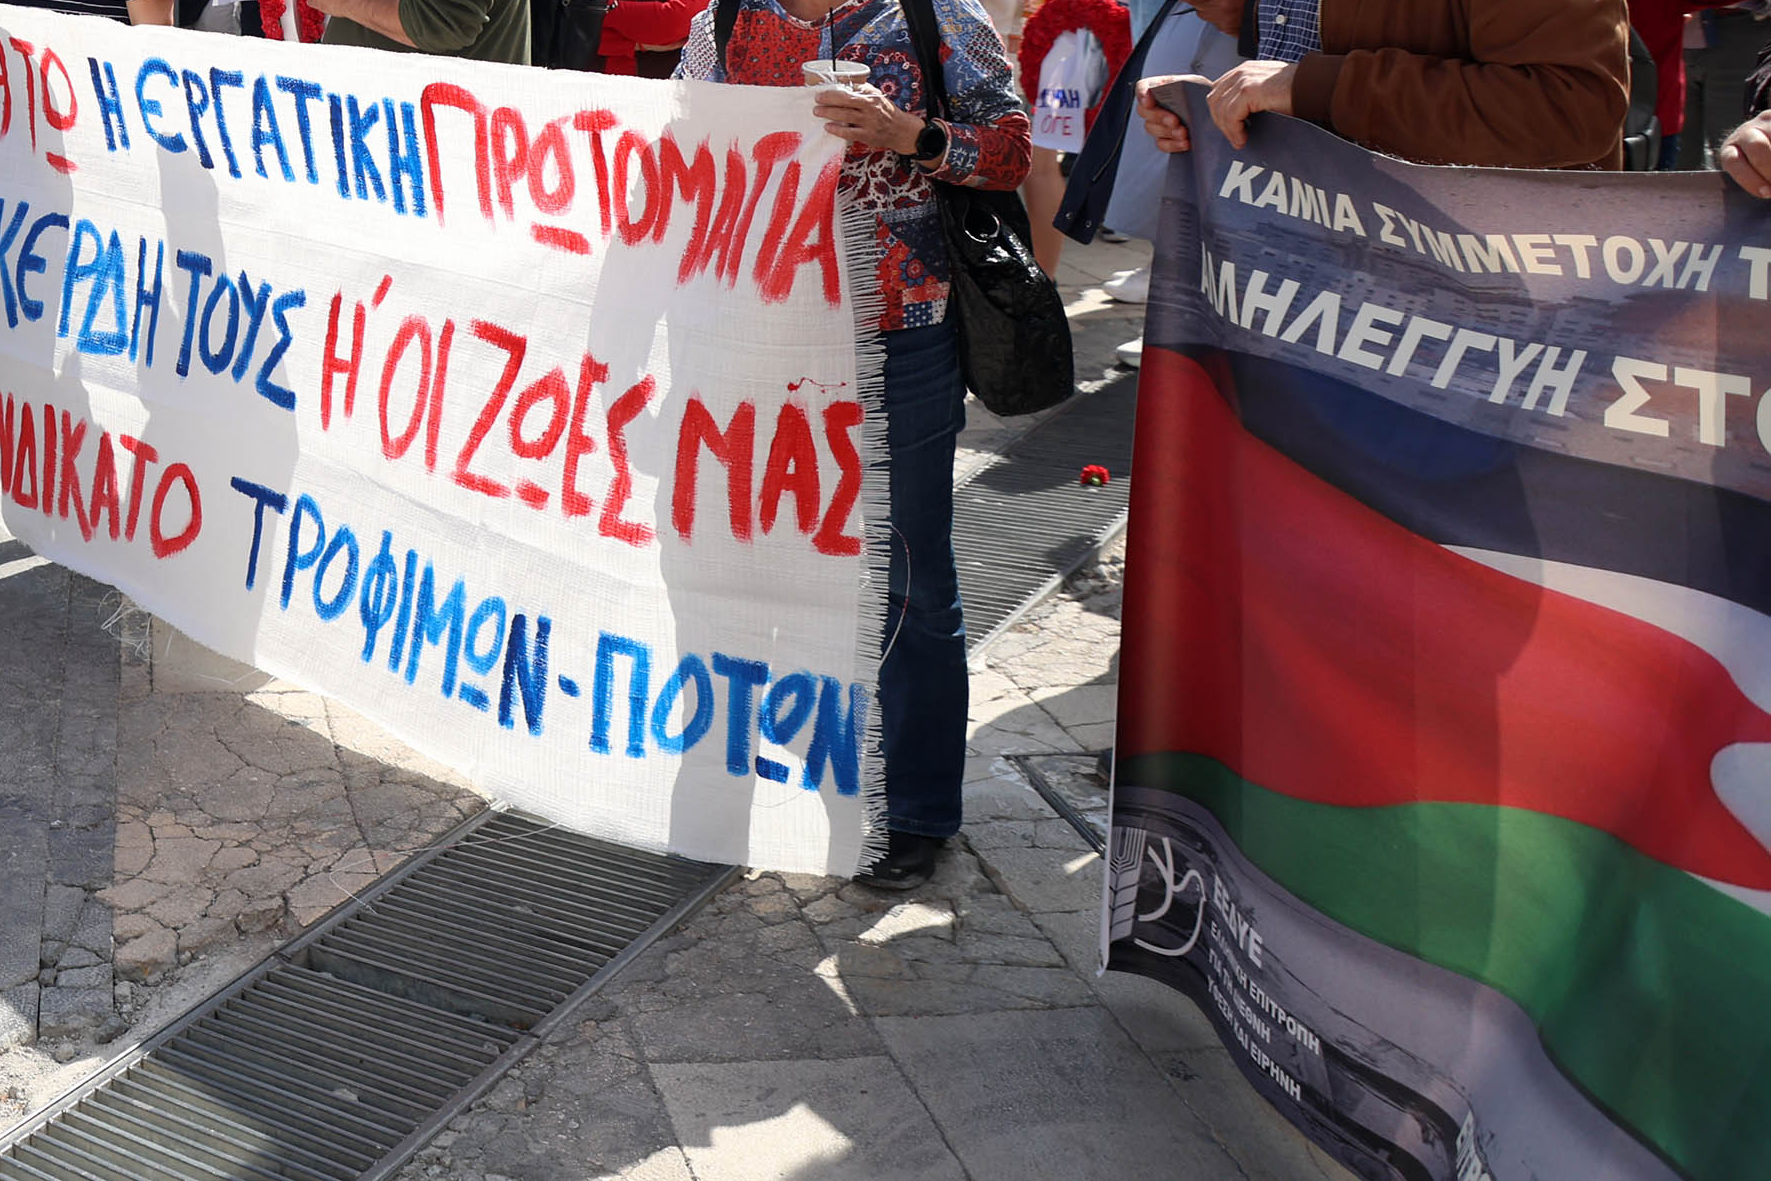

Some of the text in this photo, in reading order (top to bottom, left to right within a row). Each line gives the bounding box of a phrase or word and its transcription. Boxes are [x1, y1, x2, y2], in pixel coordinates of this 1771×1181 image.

[87, 56, 131, 153] Η
[135, 56, 429, 218] ΕΡΓΑΤΙΚΗ
[1218, 160, 1367, 238] ΚΑΜΙΑ
[1371, 200, 1725, 293] ΣΥΜΜΕΤΟΧΗ
[175, 248, 307, 412] ΤΟΥΣ
[378, 314, 456, 476] ΟΙ
[671, 389, 865, 557] ΜΑΣ
[1602, 354, 1771, 457] ΣΤ
[1214, 874, 1264, 969] ΕΕΔΥΕ
[1249, 979, 1320, 1056] ΕΠΙΤΡΟΠΗ
[1250, 1041, 1301, 1102] ΕΙΡΗΝΗ
